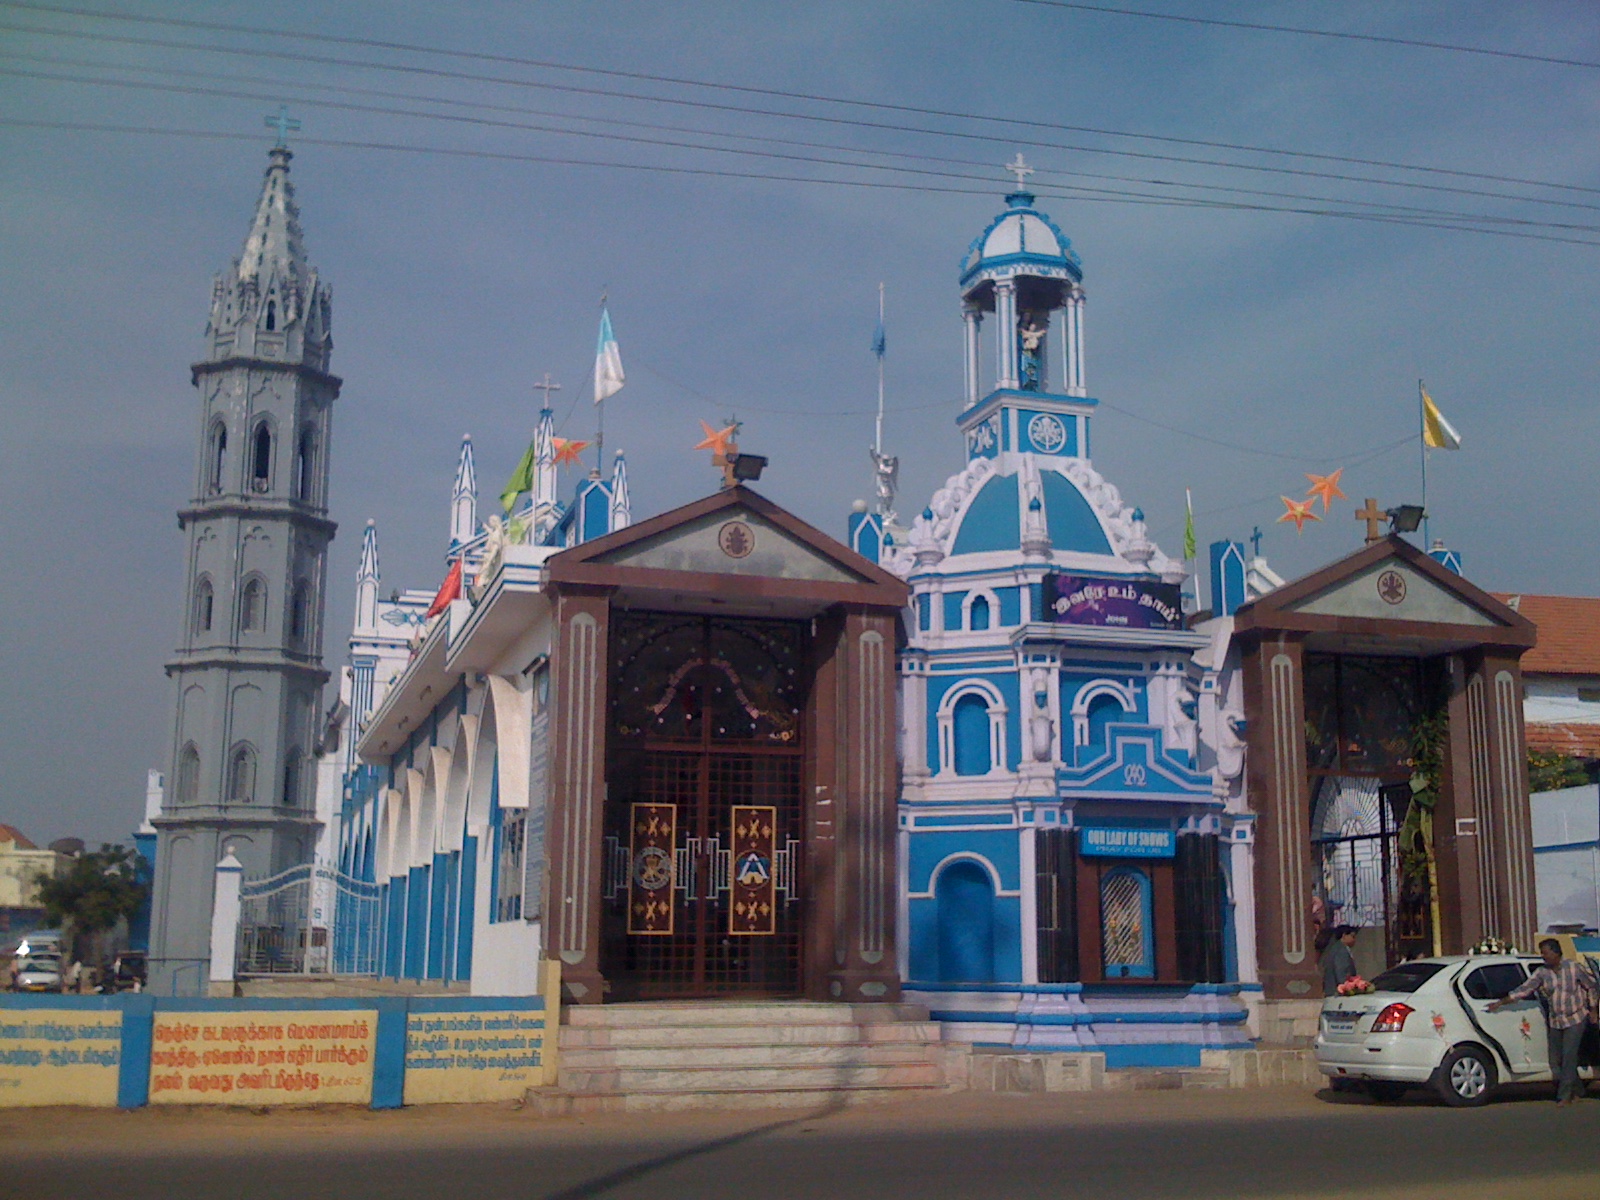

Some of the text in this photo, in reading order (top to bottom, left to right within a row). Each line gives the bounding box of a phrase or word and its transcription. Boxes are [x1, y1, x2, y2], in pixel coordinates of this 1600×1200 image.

[1088, 830, 1170, 848] OUR LADY OF SNOWS
